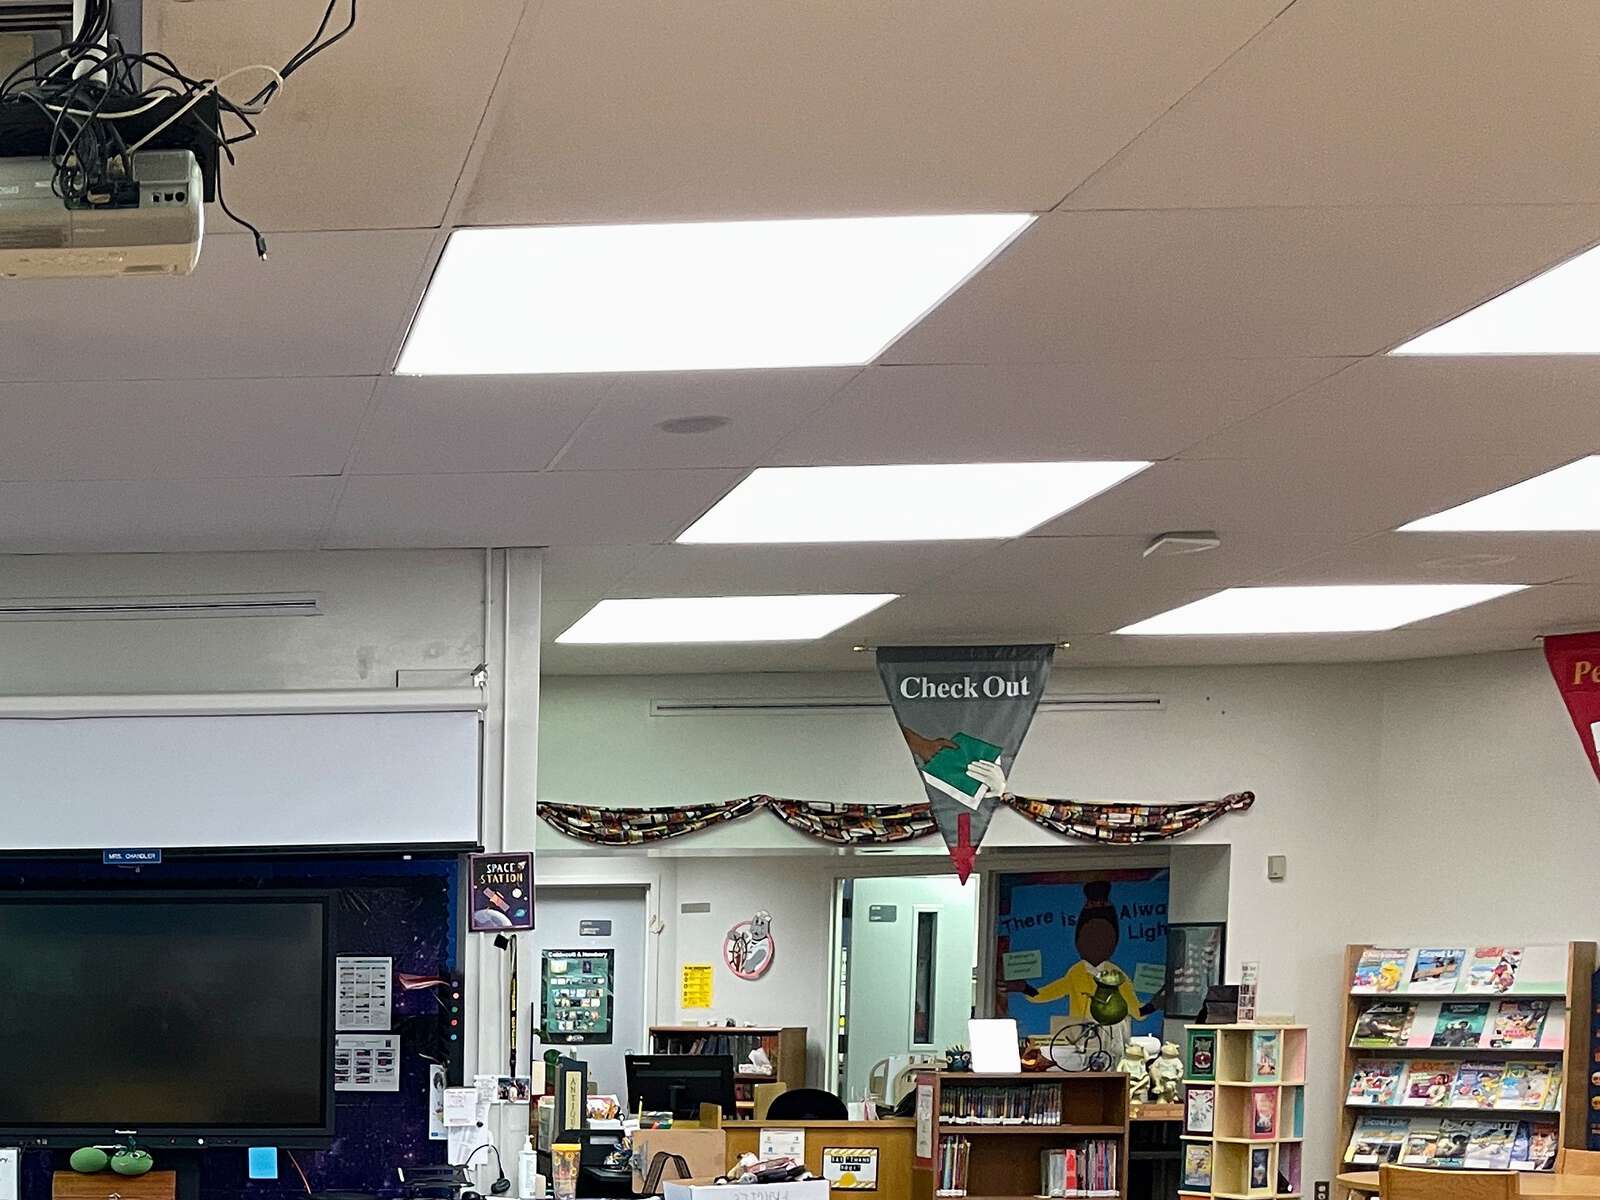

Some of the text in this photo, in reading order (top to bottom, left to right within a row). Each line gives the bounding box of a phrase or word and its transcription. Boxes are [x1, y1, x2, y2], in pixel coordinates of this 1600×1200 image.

[900, 674, 1031, 699] Check Out
[486, 862, 516, 874] SPACE
[480, 873, 523, 885] STATION
[1001, 911, 1076, 933] There is
